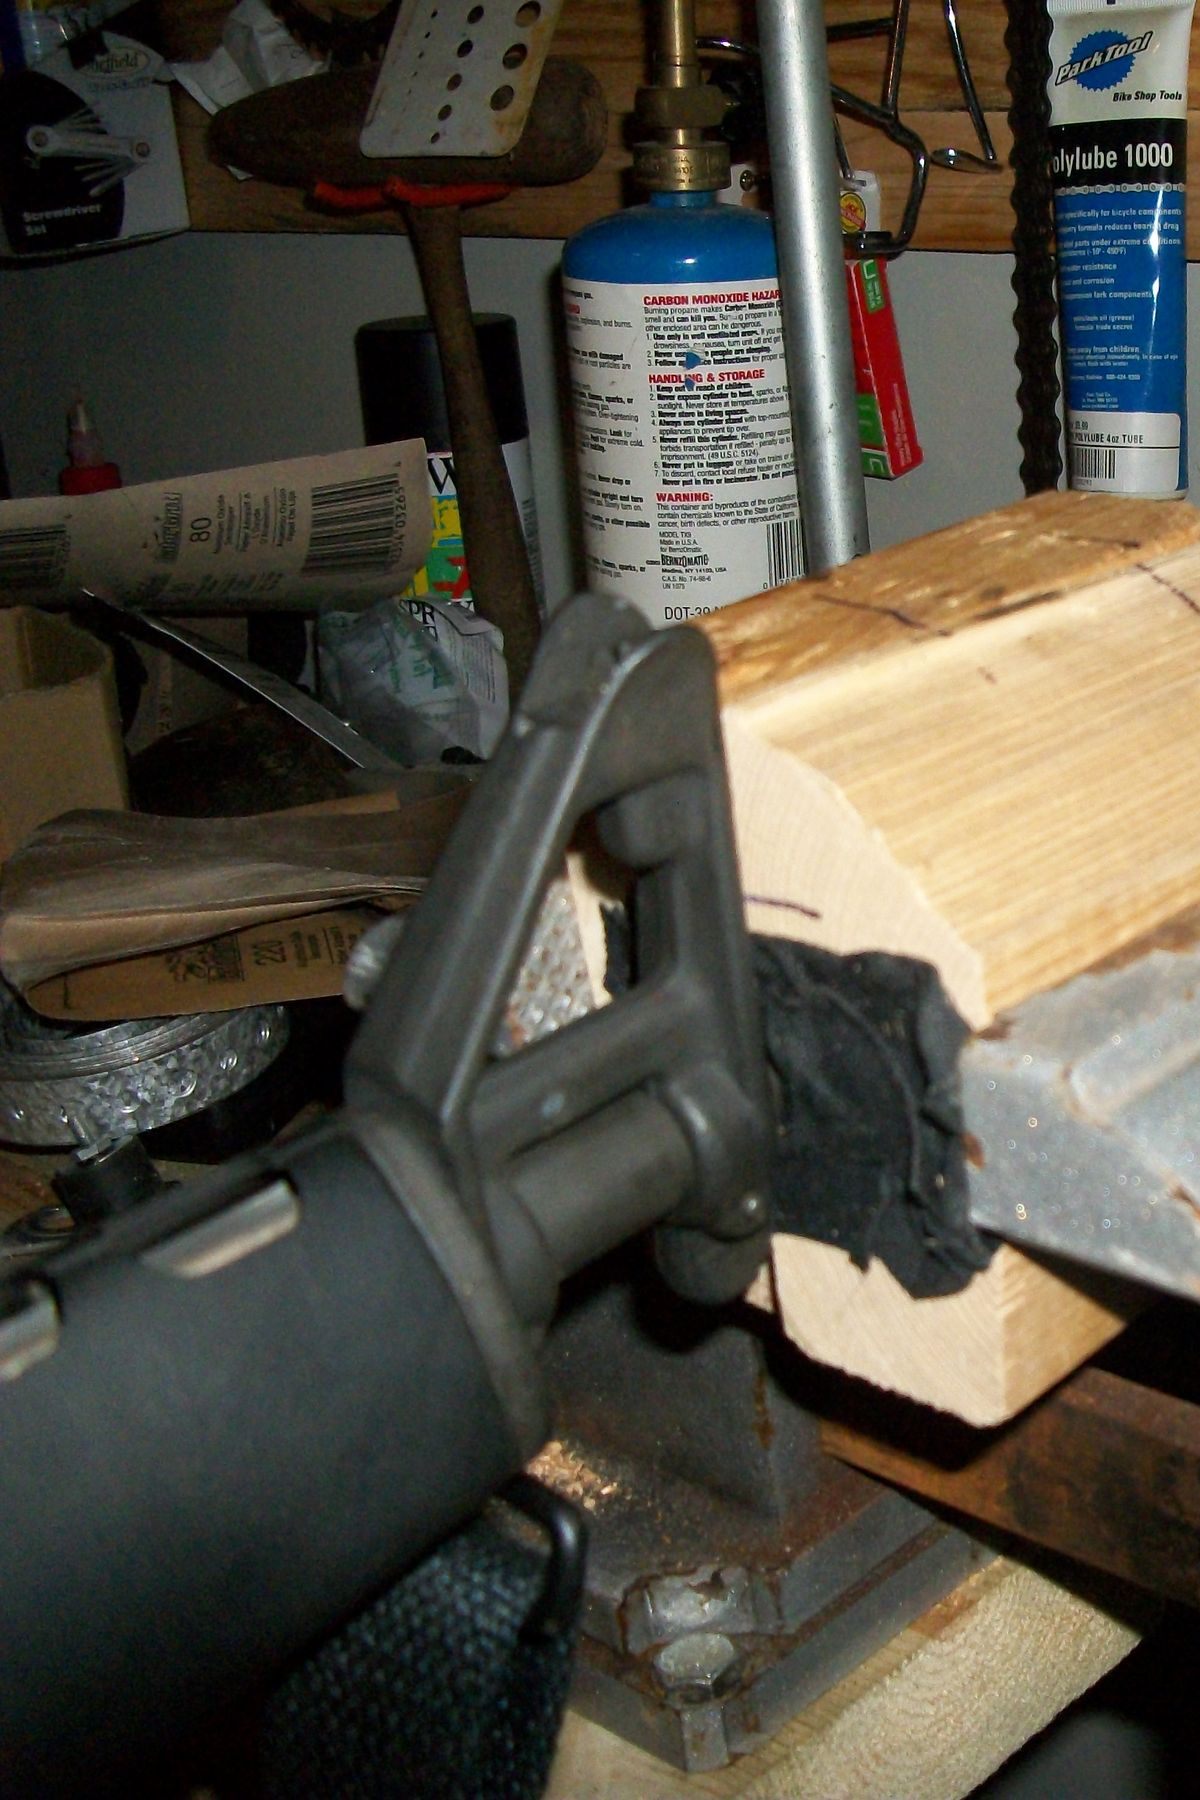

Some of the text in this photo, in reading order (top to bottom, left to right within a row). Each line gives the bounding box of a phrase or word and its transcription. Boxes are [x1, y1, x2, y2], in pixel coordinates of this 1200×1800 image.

[1113, 91, 1182, 102] Bike Shop Tools
[1052, 143, 1173, 177] olylube 1000
[1112, 209, 1136, 217] bicycle
[1163, 222, 1179, 231] drag
[644, 290, 781, 305] CARBON MONOXIDE HAZAR
[644, 302, 775, 315] Burning propane makes Monoxide
[745, 310, 767, 321] propane
[646, 324, 661, 332] other
[663, 323, 691, 331] enclosed
[731, 321, 762, 329] dangerous.
[667, 333, 681, 342] only
[707, 330, 739, 338] ventilated
[711, 349, 732, 358] people
[761, 354, 778, 363] proper
[649, 369, 765, 383] HANDLNG & STORAGE
[703, 391, 729, 400] cylinder
[731, 396, 769, 407] temperatures
[706, 409, 723, 417] living
[659, 420, 681, 428] Always
[697, 418, 723, 426] cylinder
[660, 427, 692, 436] appliances
[702, 426, 725, 435] prevent
[741, 431, 763, 440] Refilling
[1123, 434, 1143, 444] TUBE
[683, 442, 727, 452] transportation
[735, 440, 754, 449] refilled
[661, 453, 705, 462] imprisonment.
[706, 460, 734, 469] luggage
[671, 470, 696, 478] discard,
[722, 467, 736, 475] local
[738, 465, 755, 473] refuse
[682, 478, 693, 486] put
[656, 492, 714, 502] WARNING:
[715, 501, 749, 510] byproducts
[681, 510, 712, 519] chemicals
[658, 520, 679, 528] cancer,
[681, 519, 695, 528] birth
[697, 519, 721, 527] defects,
[731, 517, 746, 526] other
[748, 512, 781, 524] reproductive
[189, 517, 212, 543] 80
[661, 554, 709, 567] BERNZOMATIC
